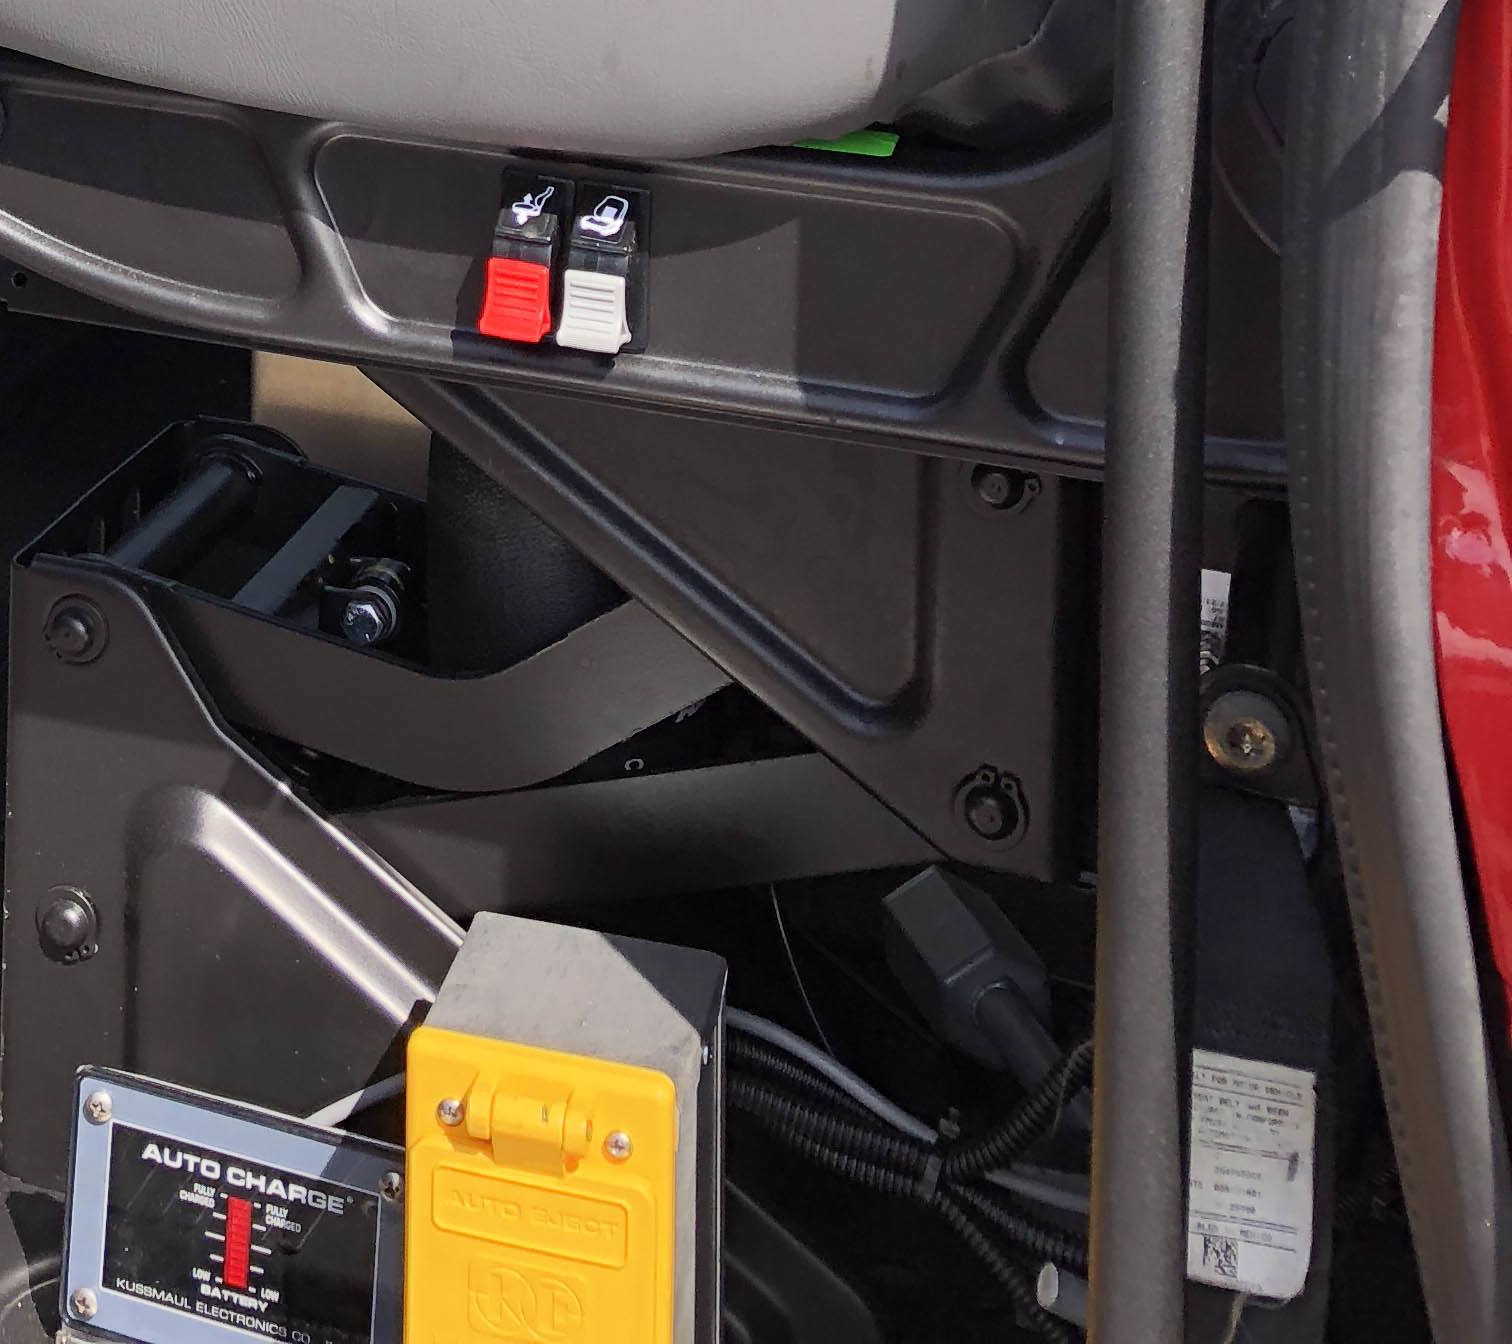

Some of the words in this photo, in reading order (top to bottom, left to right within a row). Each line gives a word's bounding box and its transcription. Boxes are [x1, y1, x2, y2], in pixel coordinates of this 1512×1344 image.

[141, 1142, 221, 1180] AUTO
[226, 1166, 346, 1216] CHARGE
[178, 1189, 216, 1209] CHARGED
[193, 1182, 217, 1198] FULLY
[265, 1203, 289, 1218] FULLY
[448, 1189, 523, 1218] AUTO
[529, 1207, 620, 1241] EJECT
[265, 1215, 302, 1234] CHARGED
[192, 1266, 211, 1283] LOW
[199, 1283, 269, 1314] BATTERY
[260, 1287, 280, 1304] LOW
[115, 1276, 192, 1311] KUSSMAUL
[195, 1300, 288, 1338] ELECTRONICS
